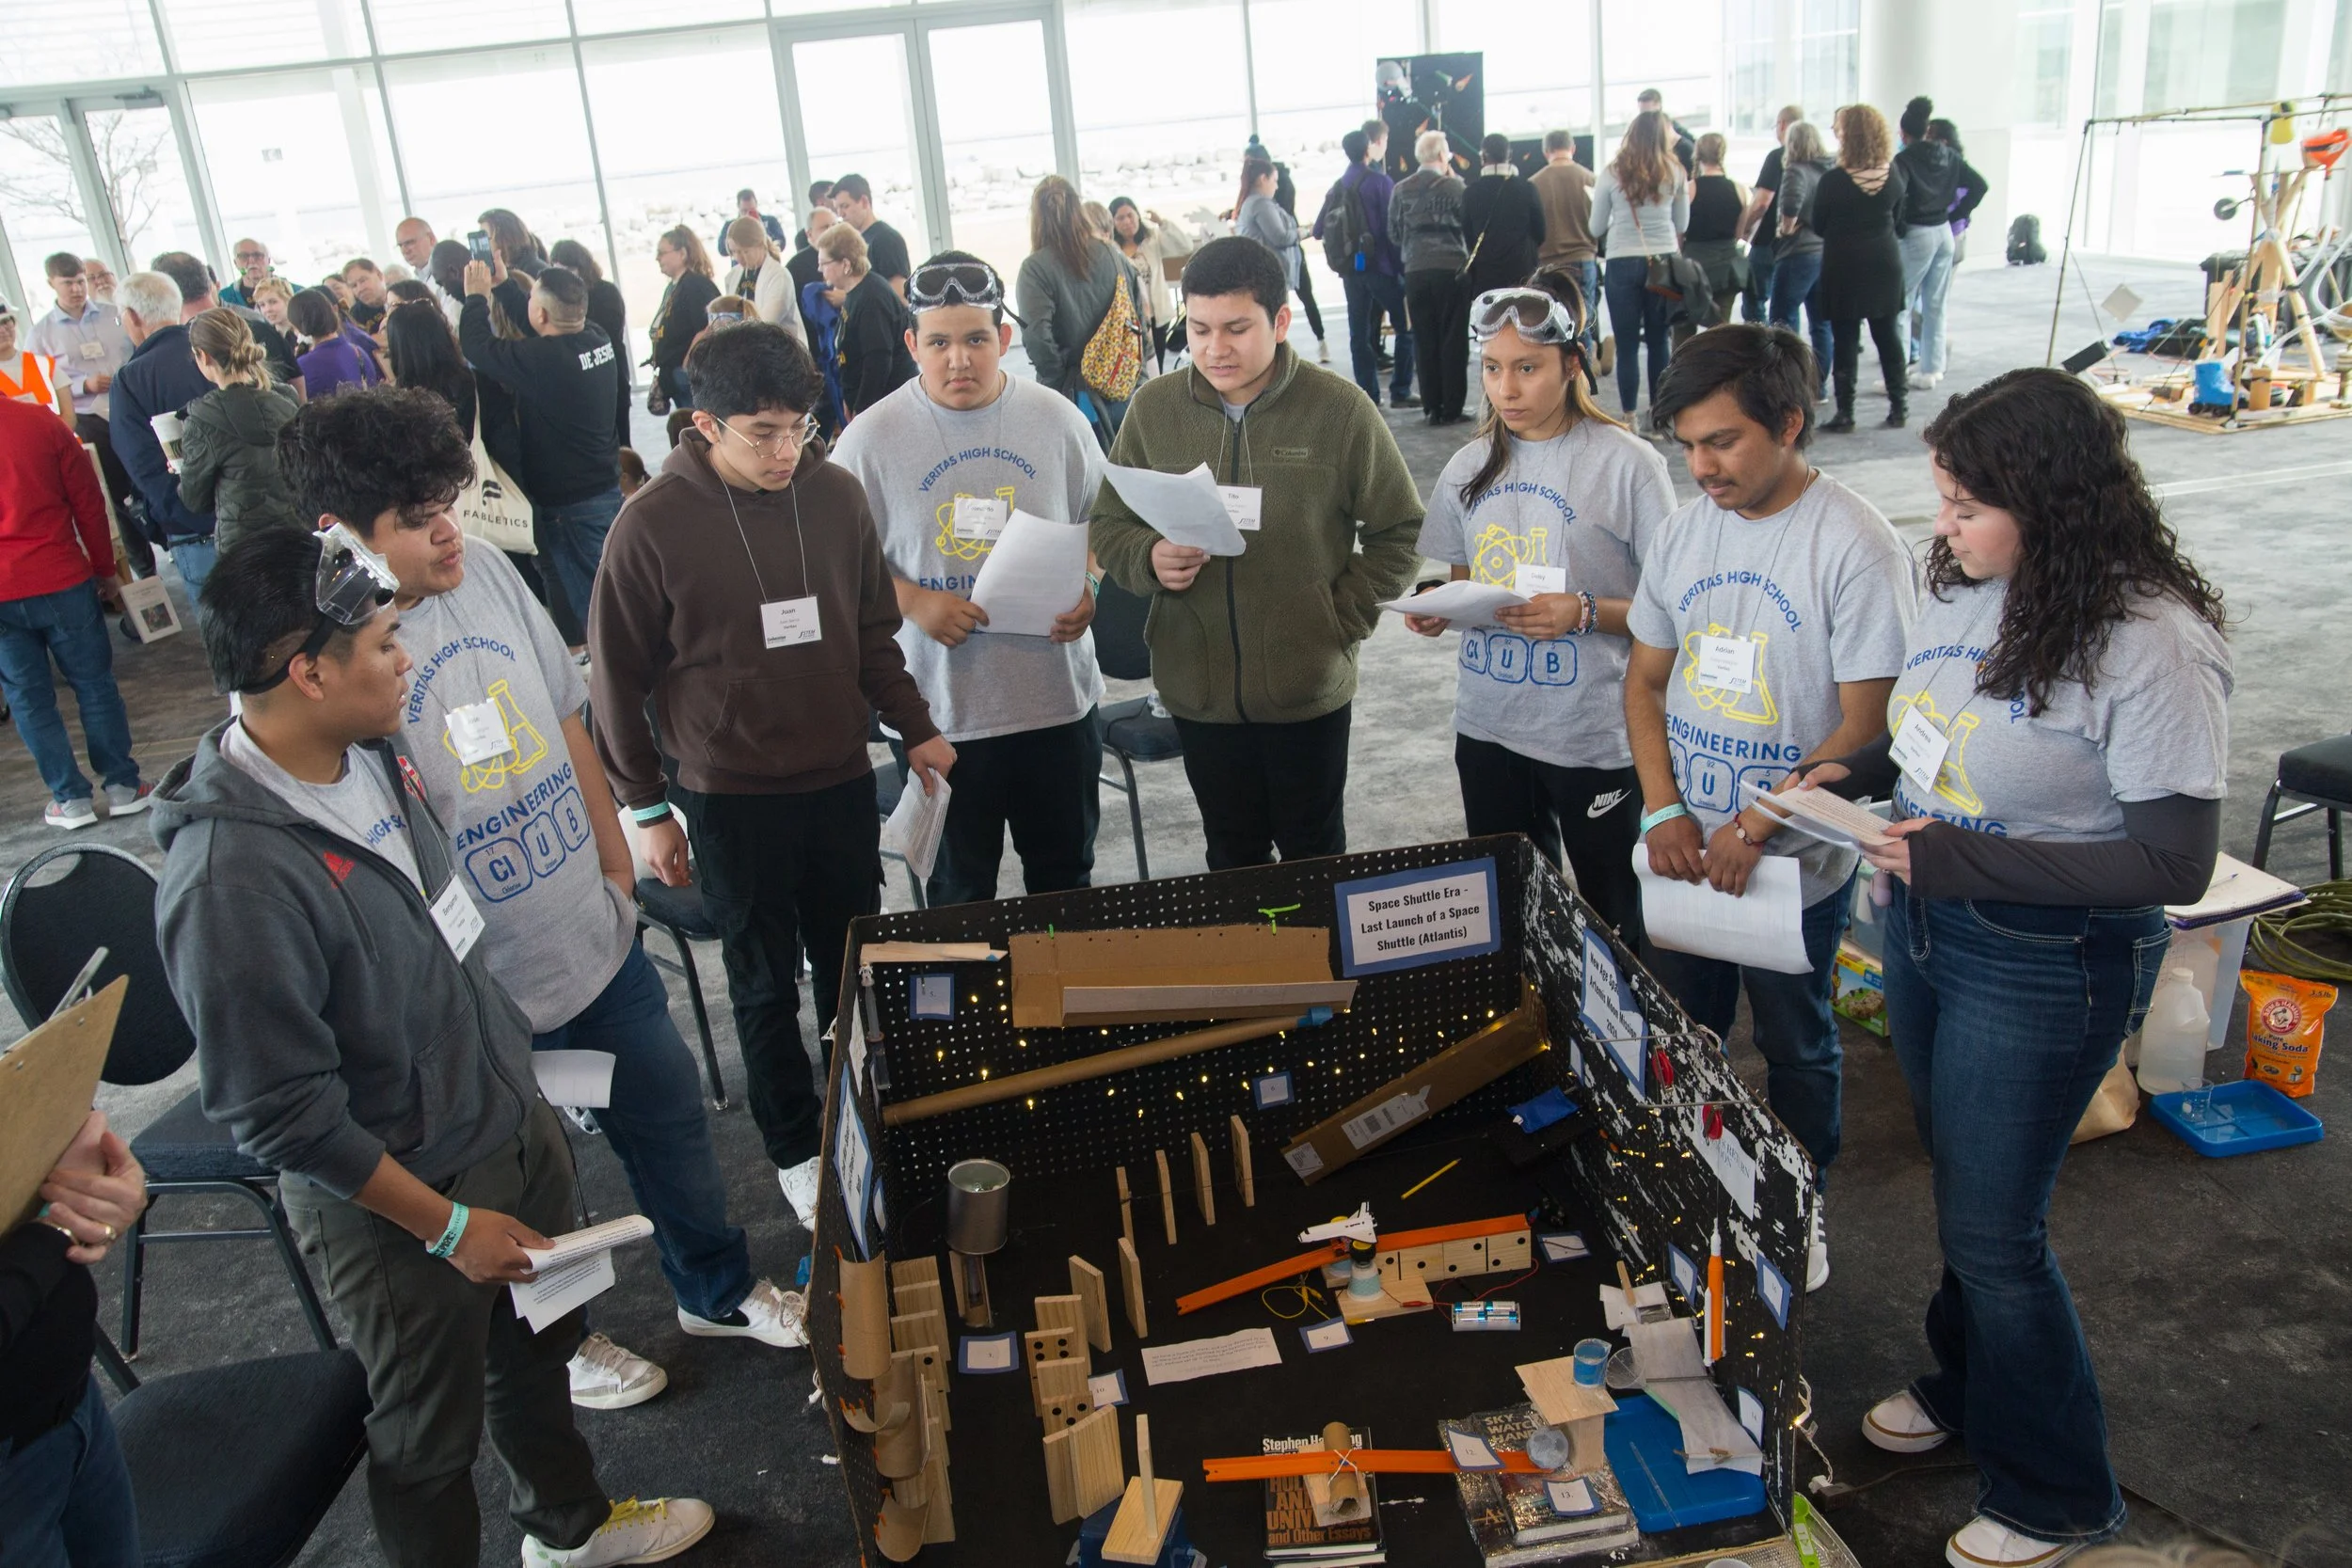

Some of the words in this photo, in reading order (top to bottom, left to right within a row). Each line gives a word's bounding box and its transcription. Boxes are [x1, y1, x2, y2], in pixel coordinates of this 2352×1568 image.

[579, 352, 594, 371] DE
[918, 455, 958, 493] VERITAS
[960, 447, 991, 462] HIGH
[993, 448, 1037, 480] SCHOOL
[1504, 483, 1537, 494] HIGH
[1539, 485, 1577, 526] SCHOOL
[464, 510, 528, 528] FABLETICS
[1678, 573, 1724, 612] VERITAS
[1727, 571, 1762, 587] HIGH
[1762, 578, 1803, 633] SCHOOL
[1502, 649, 1513, 669] U
[1546, 652, 1560, 673] B
[1715, 645, 1735, 655] Adrian
[1906, 644, 1964, 671] VERITAS
[407, 665, 436, 724] VERITAS
[431, 640, 463, 669] HIGH
[463, 636, 516, 662] SCHOOL
[1666, 713, 1802, 762] ENGINEERING
[1707, 760, 1715, 768] 92
[1702, 772, 1715, 796] U
[455, 762, 572, 851] ENGINEERING
[1593, 789, 1622, 808] NIKE
[536, 832, 549, 857] U
[566, 807, 578, 833] B
[485, 847, 494, 856] 17
[1368, 898, 1400, 912] Space
[1403, 890, 1441, 906] Shuttle
[1444, 888, 1461, 897] Era
[1361, 921, 1383, 934] Last
[1386, 914, 1423, 929] Launch
[1426, 911, 1437, 923] of
[1449, 905, 1480, 919] Space
[1376, 936, 1415, 951] Shuttle
[1419, 926, 1468, 945] (Atlantis)
[1590, 951, 1599, 972] New
[1599, 964, 1609, 982] Age
[1590, 974, 1606, 1005] Artemis
[1606, 997, 1619, 1020] Moon
[1606, 1018, 1618, 1039] 2024
[2282, 1041, 2308, 1053] Soda
[1485, 1414, 1514, 1426] SKY
[1263, 1436, 1309, 1452] Stephen
[1268, 1531, 1291, 1544] and
[1294, 1528, 1325, 1543] Other
[1327, 1527, 1371, 1543] Essays
